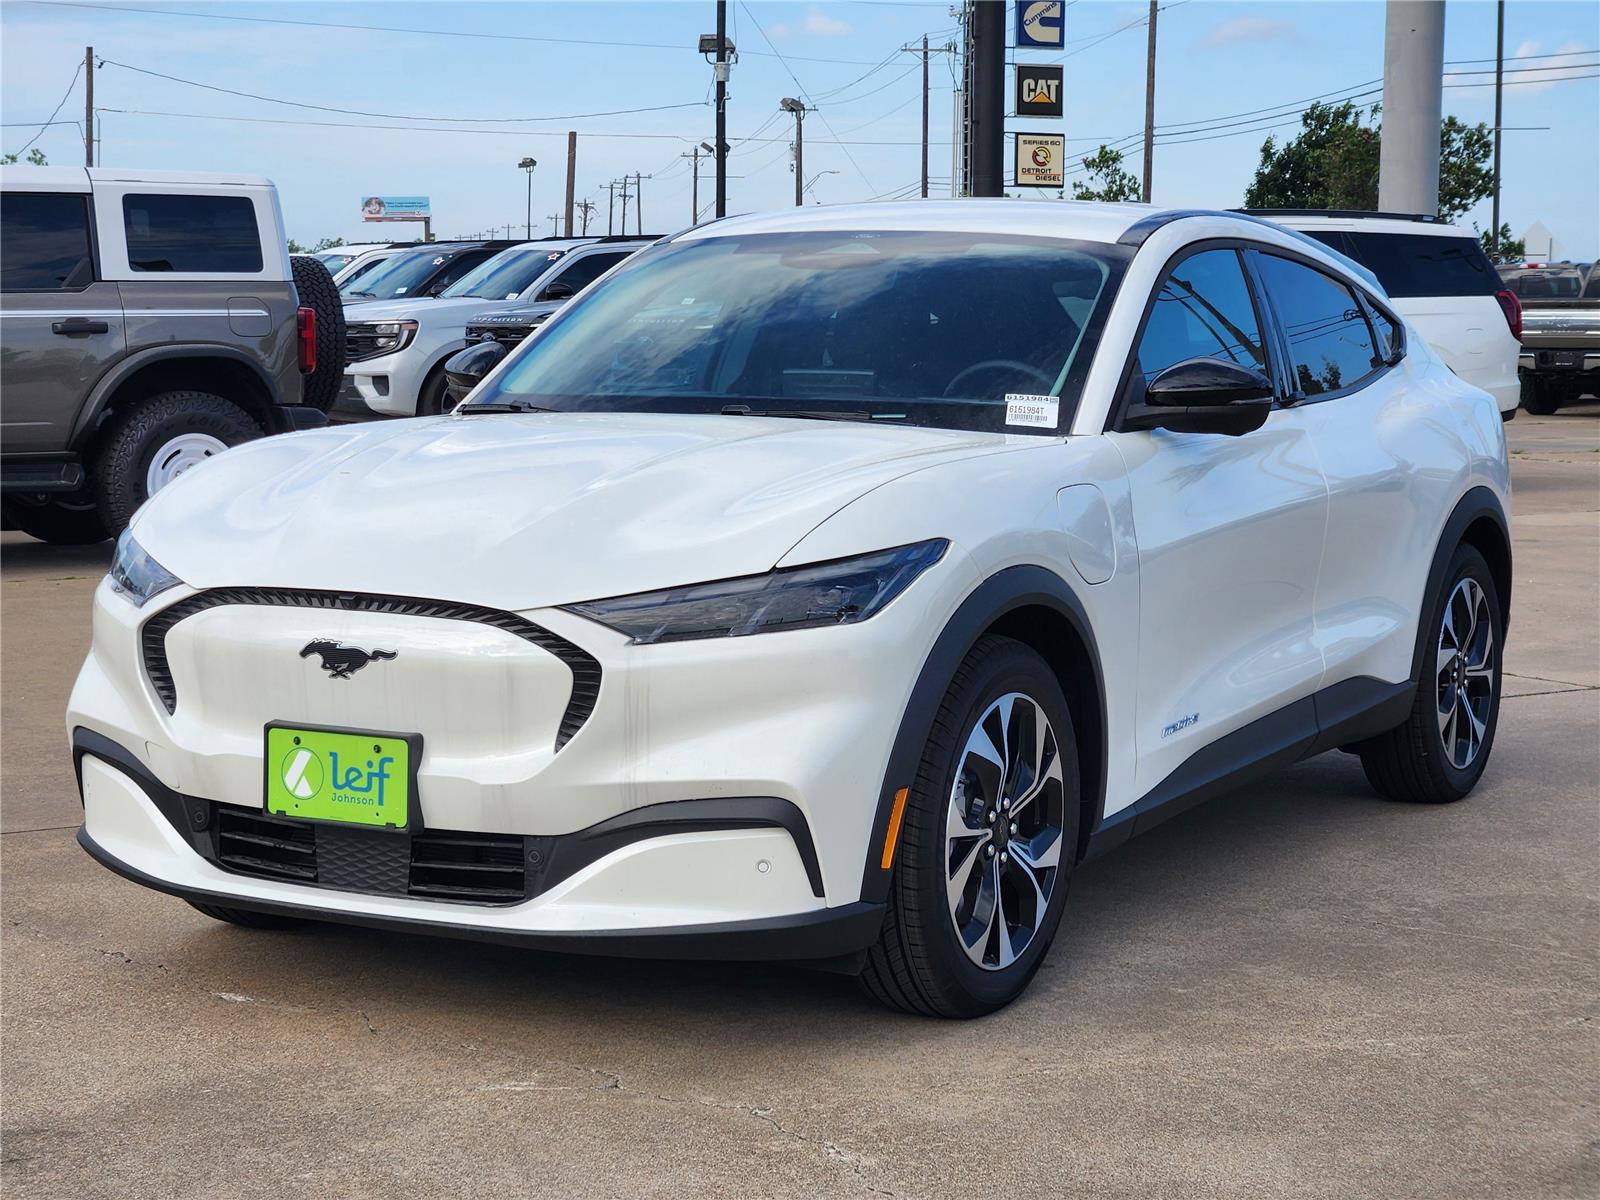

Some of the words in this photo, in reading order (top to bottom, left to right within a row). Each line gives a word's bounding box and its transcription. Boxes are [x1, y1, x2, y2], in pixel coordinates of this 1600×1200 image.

[1023, 2, 1057, 26] Cummins
[1022, 78, 1060, 104] CAT
[1008, 404, 1045, 415] 6151984T
[329, 751, 394, 807] leif
[331, 793, 375, 806] Johnson
